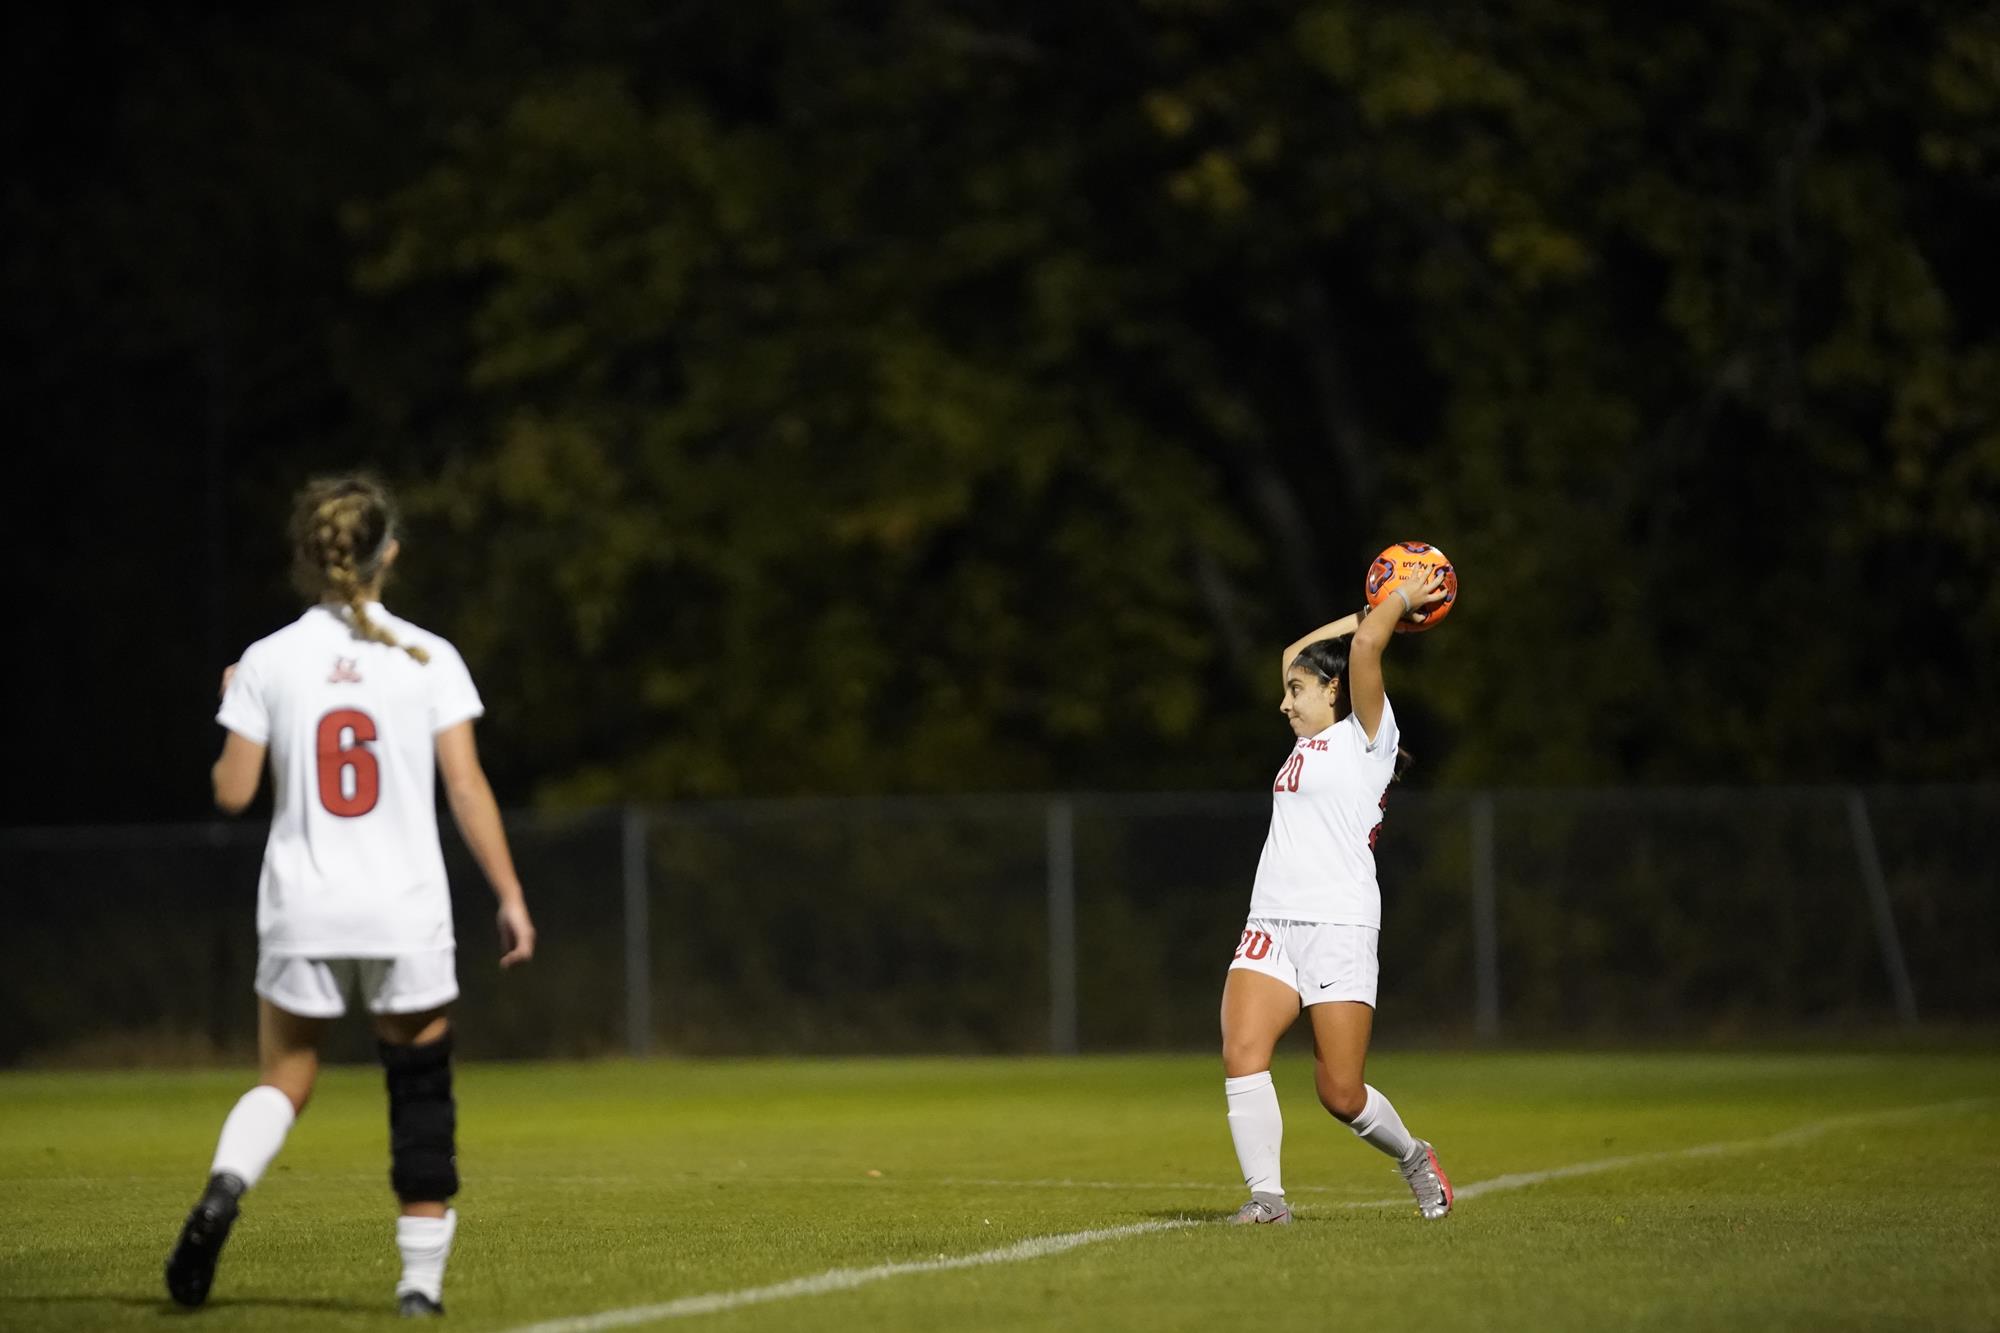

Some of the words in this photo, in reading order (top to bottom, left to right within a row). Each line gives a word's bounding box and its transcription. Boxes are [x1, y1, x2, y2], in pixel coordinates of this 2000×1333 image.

[316, 708, 379, 818] 6
[1274, 753, 1304, 793] 20
[1234, 929, 1273, 960] 20
